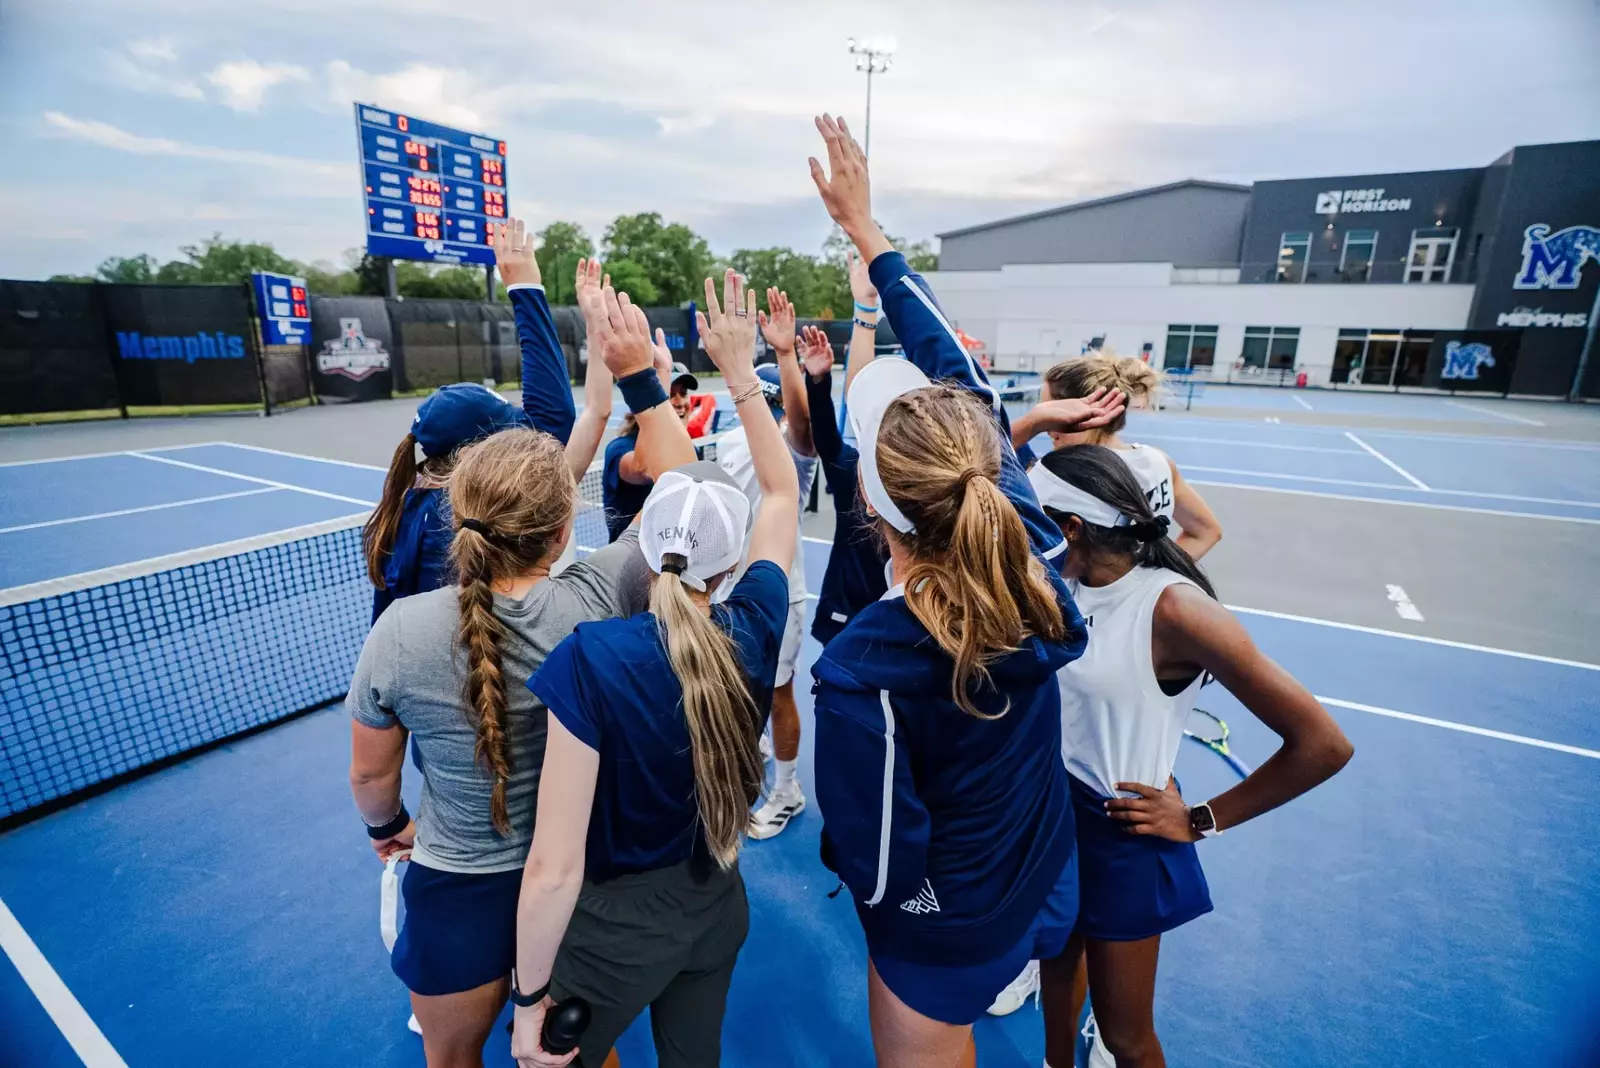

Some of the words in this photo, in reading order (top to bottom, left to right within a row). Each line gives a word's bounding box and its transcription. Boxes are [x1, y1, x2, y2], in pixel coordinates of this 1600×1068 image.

[1343, 188, 1385, 201] FIRST
[1341, 199, 1412, 213] HORIZON
[1497, 312, 1587, 327] MEMPHIS
[115, 331, 245, 364] Memphis
